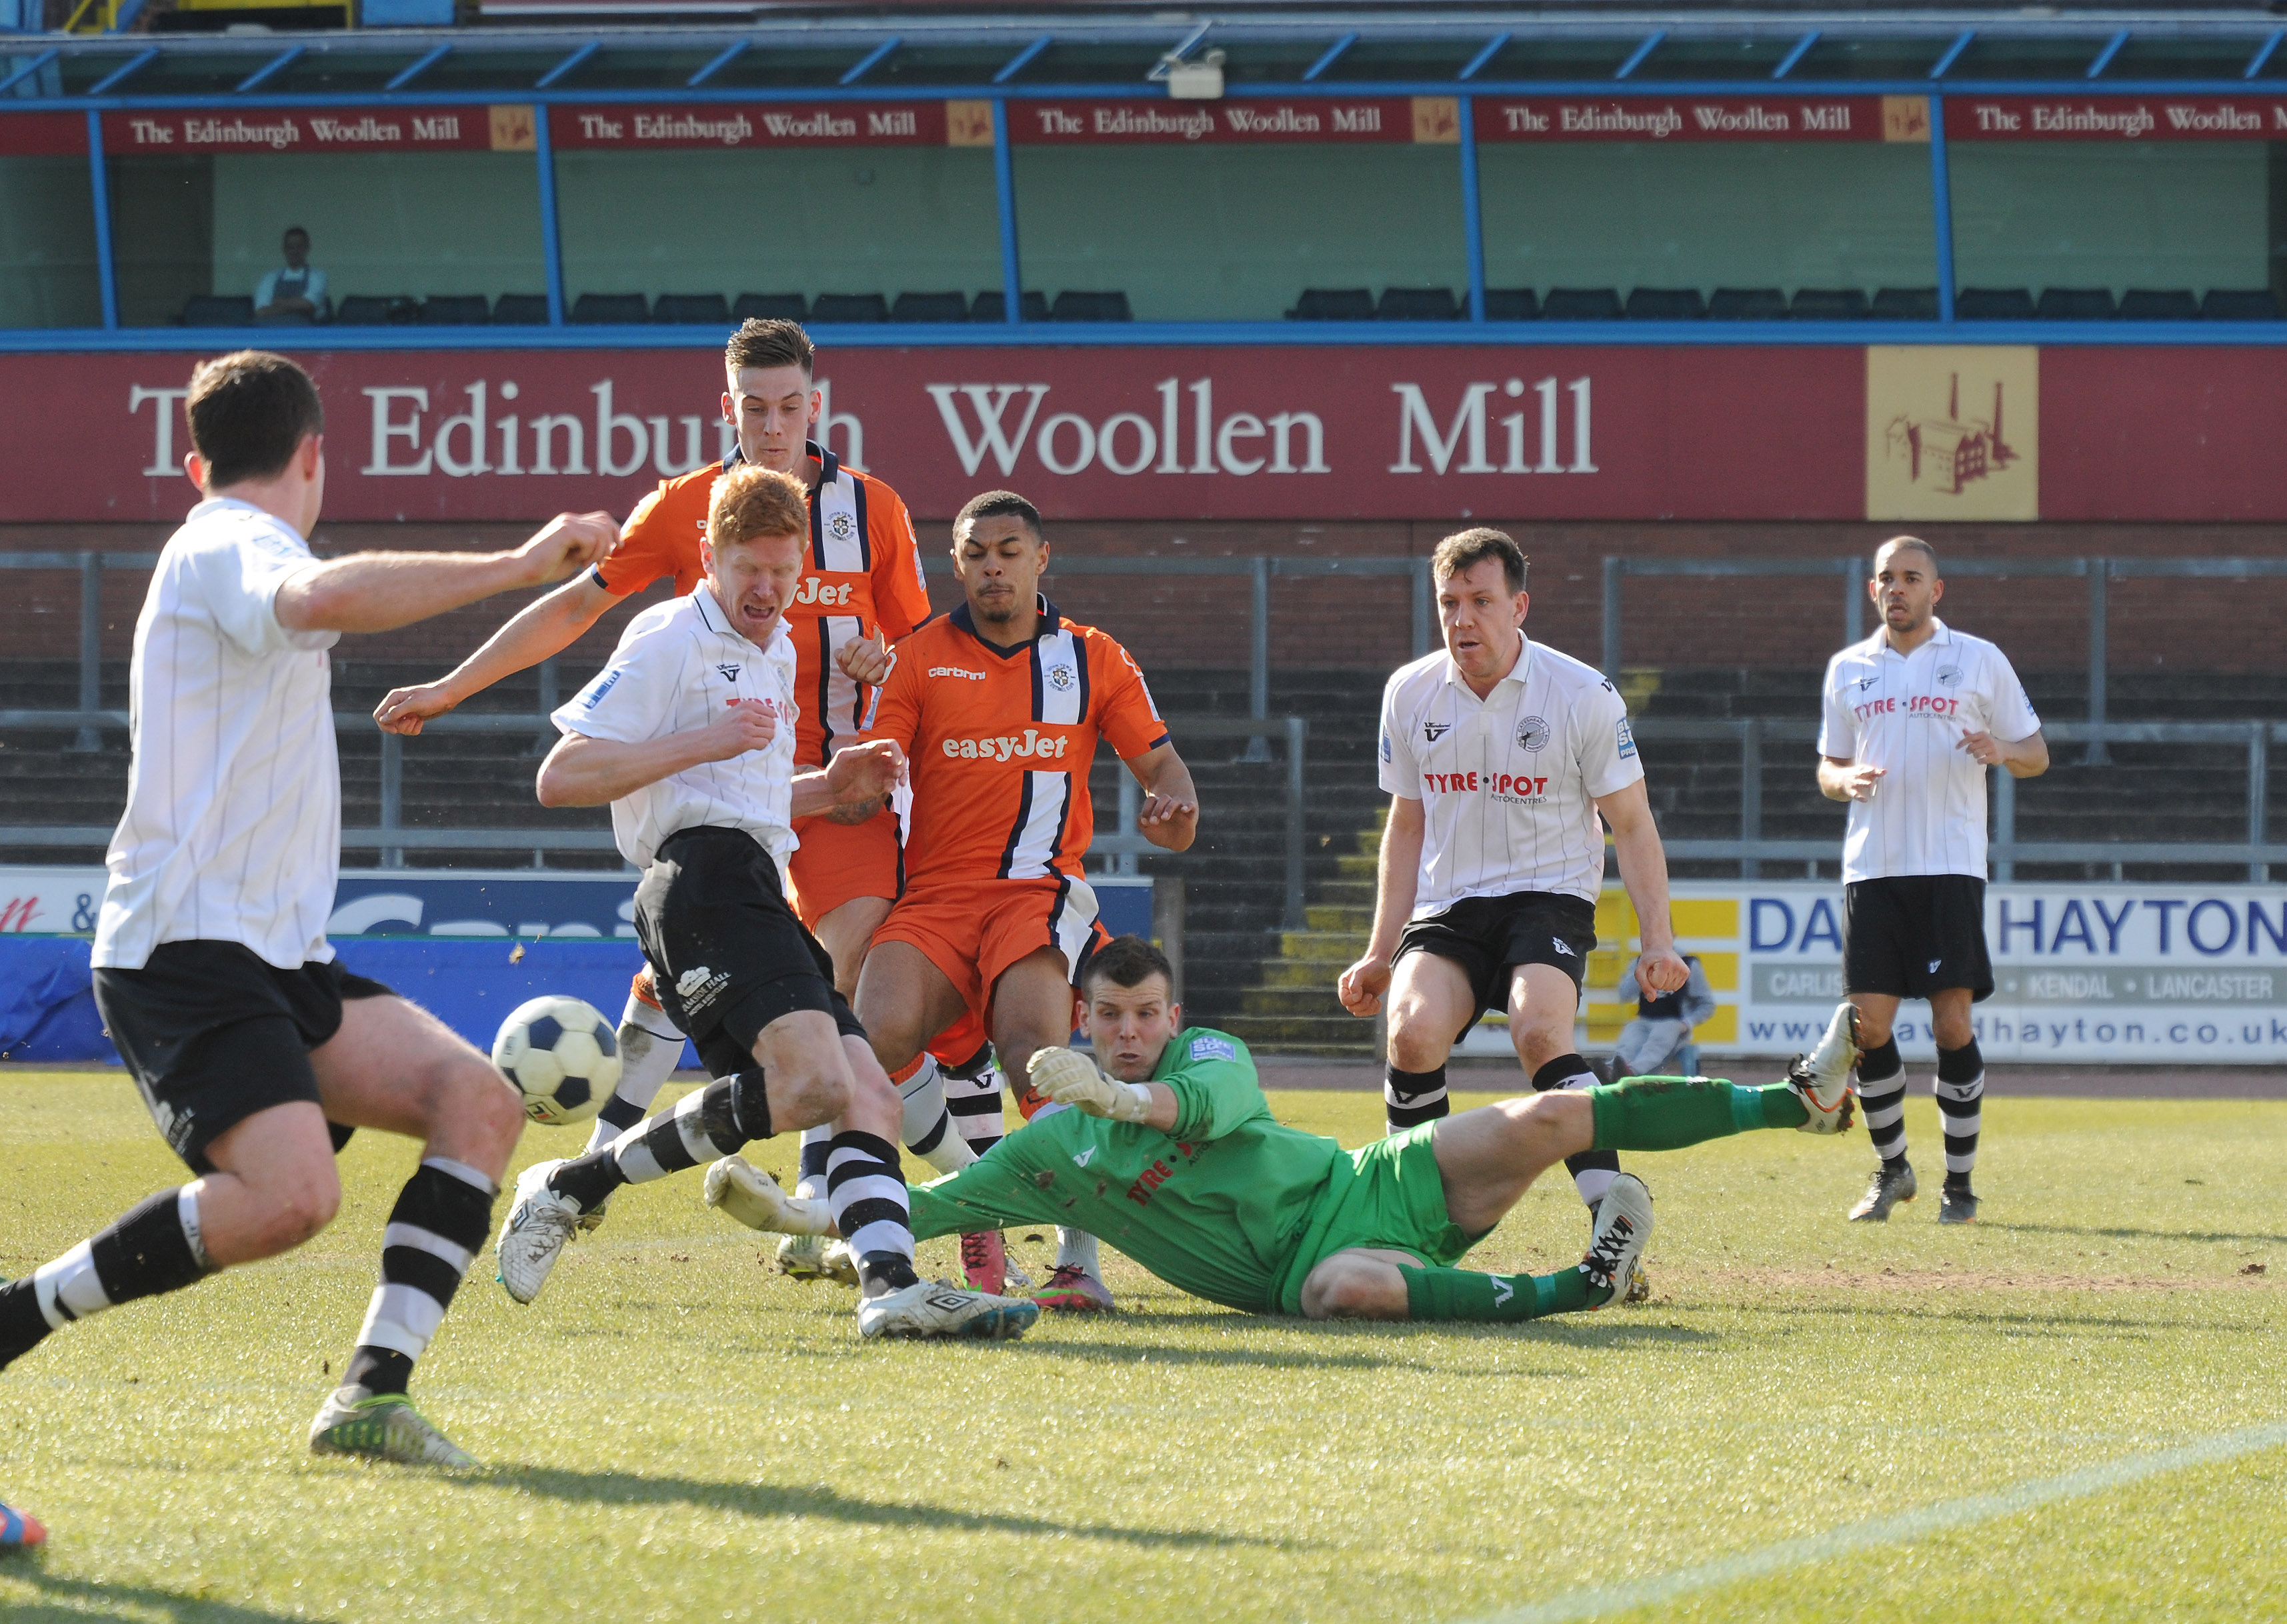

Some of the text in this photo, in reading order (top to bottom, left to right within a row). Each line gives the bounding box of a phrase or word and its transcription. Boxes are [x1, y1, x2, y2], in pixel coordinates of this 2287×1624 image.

[131, 119, 459, 148] The Edinburgh Woollen Mill
[581, 113, 915, 145] The Edinburgh Woollen Mill
[1039, 108, 1380, 139] The Edinburgh Woollen Mill
[1506, 105, 1850, 137] The Edinburgh Woollen Mill
[1976, 107, 2021, 131] The
[2032, 106, 2154, 137] Edinburgh
[2166, 105, 2262, 130] Woollen
[361, 377, 1600, 477] Edinbuh Woollen Mill
[1854, 695, 1959, 723] TYRE SPOT
[942, 729, 1068, 762] easyJet
[1424, 771, 1548, 796] TYRE SPOT
[2000, 899, 2287, 955] HAYTON
[706, 972, 731, 989] HALL
[1770, 970, 2274, 1000] CARLIS KENDAL LANCASTER
[1126, 1159, 1174, 1207] TYRE
